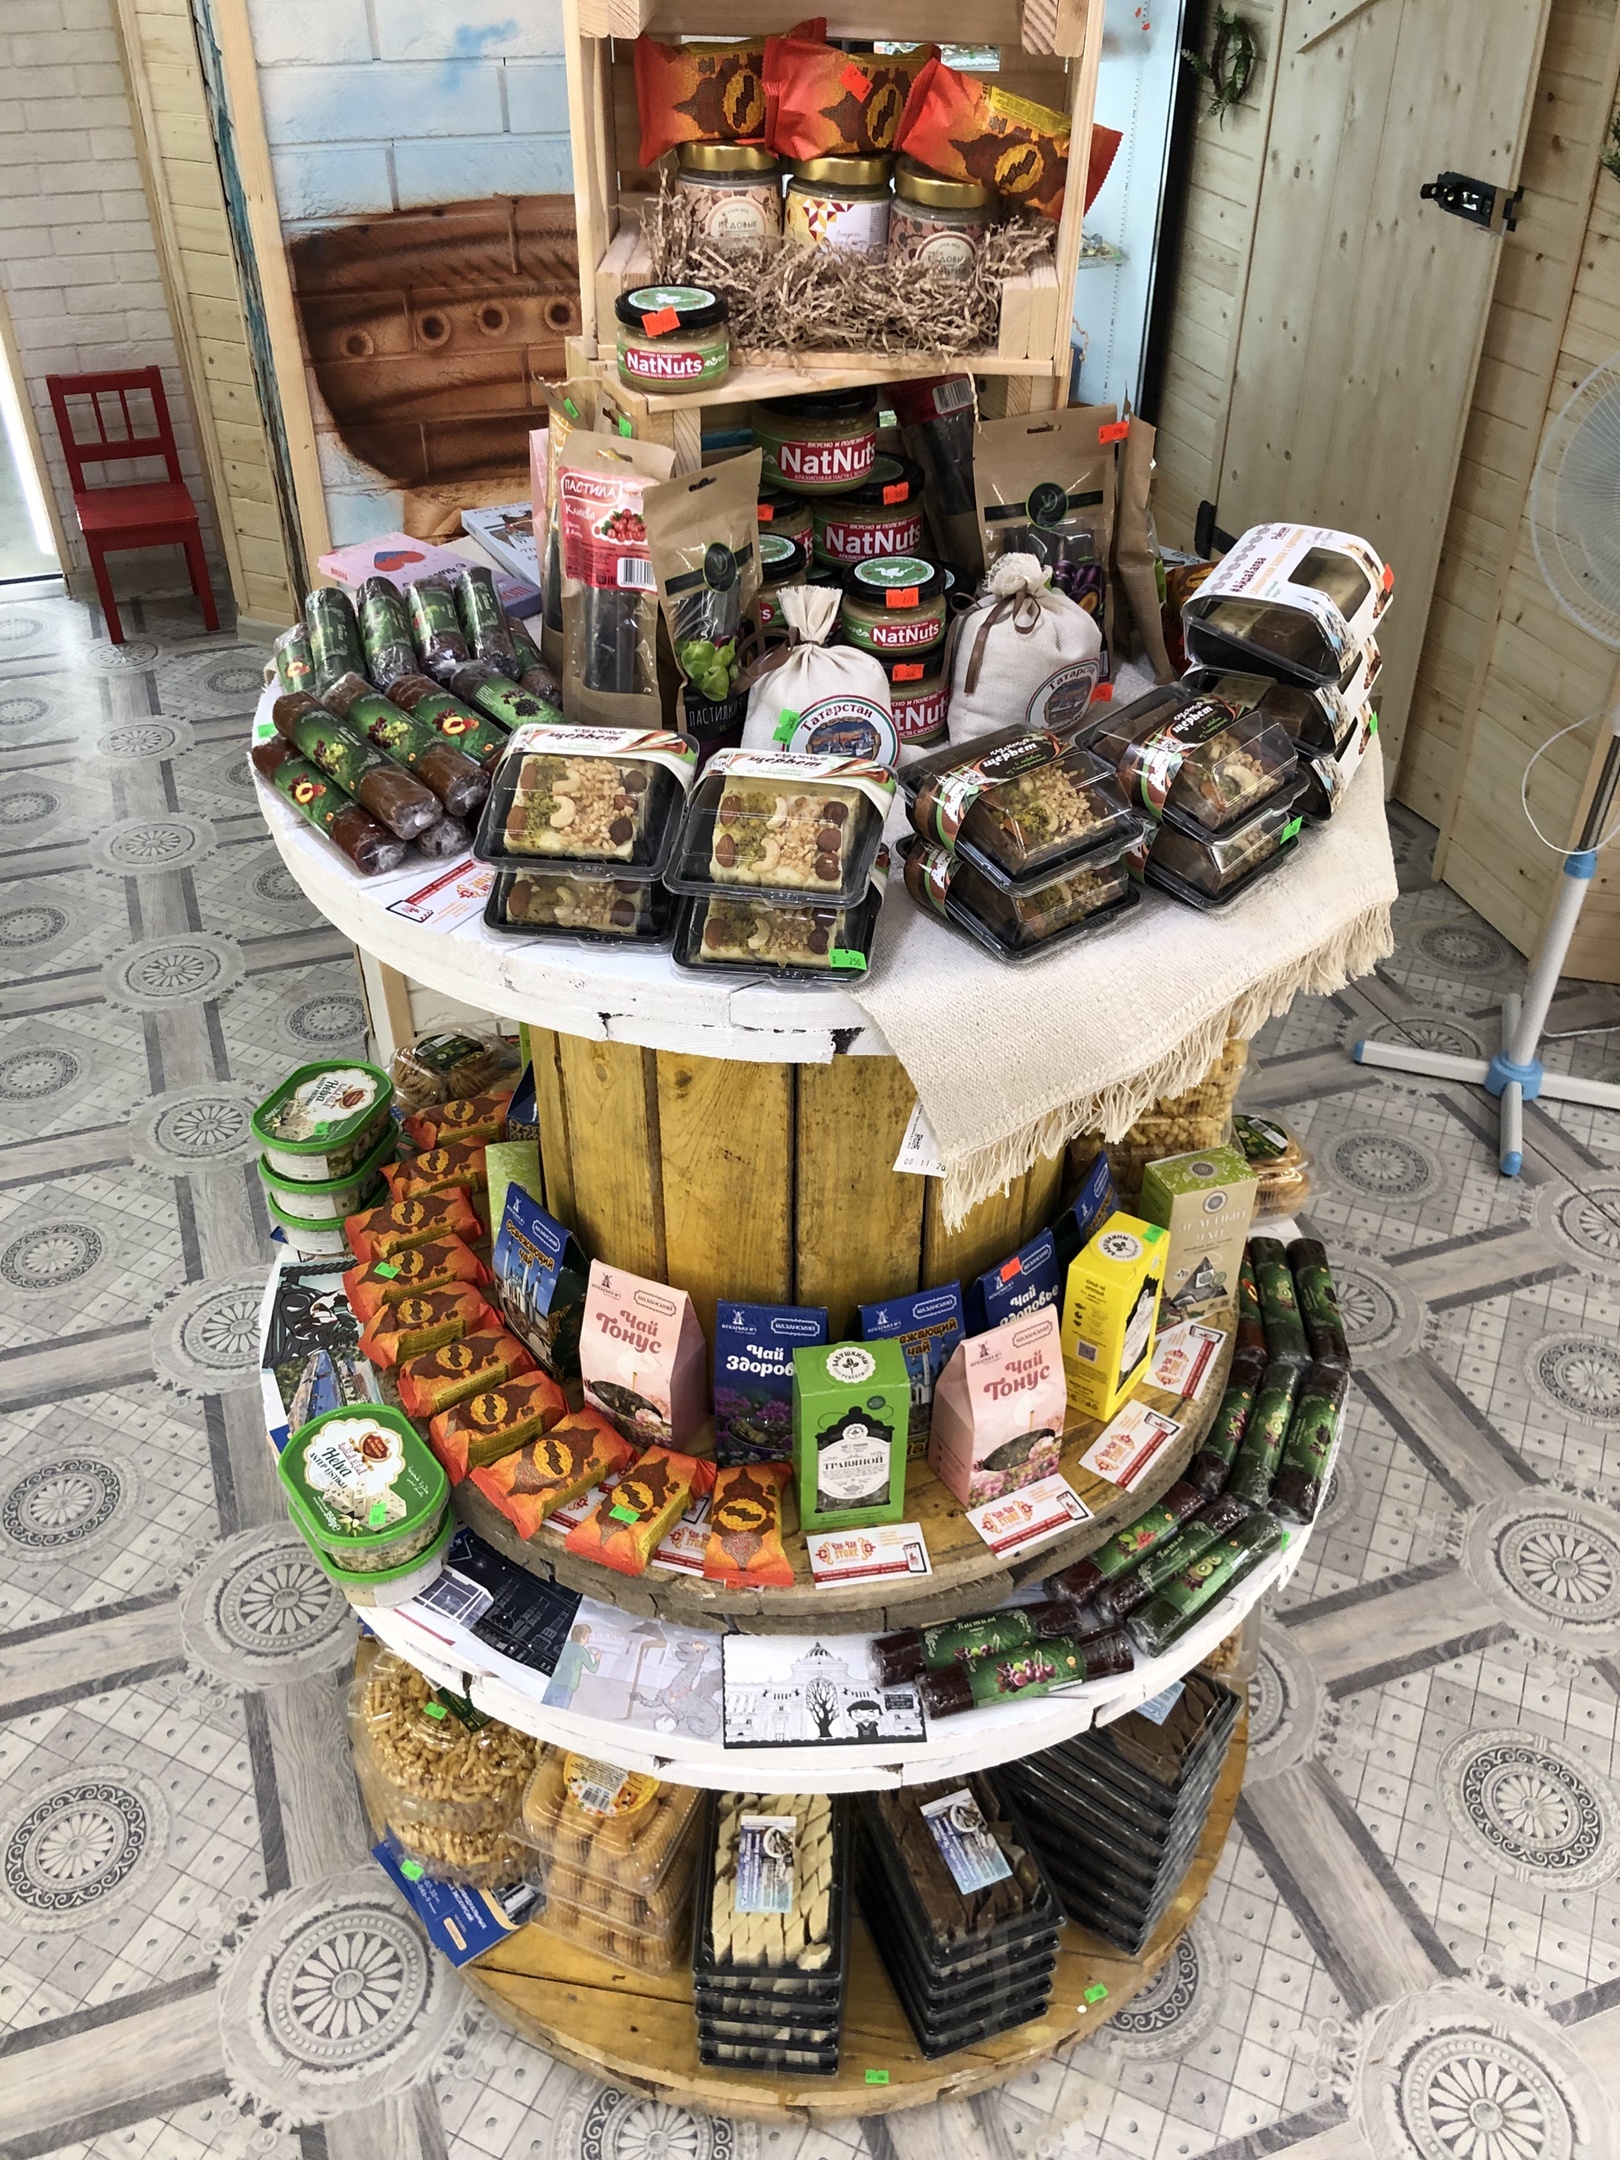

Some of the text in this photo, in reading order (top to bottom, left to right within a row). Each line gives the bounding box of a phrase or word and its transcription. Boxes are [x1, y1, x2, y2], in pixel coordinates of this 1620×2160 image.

[626, 351, 703, 375] NatNuts
[840, 436, 865, 446] ПОЛЕЗНО
[780, 441, 876, 475] NatNuts
[564, 478, 617, 499] ПАСТИЛА
[826, 524, 921, 555] NatNuts
[873, 623, 939, 643] NatNuts
[800, 703, 874, 732] Татарстан
[893, 693, 949, 730] tNut
[982, 743, 1038, 768] щербет
[849, 957, 862, 967] 250
[1010, 1284, 1037, 1306] Чай
[596, 1312, 662, 1354] Тонус
[620, 1309, 658, 1337] Чай
[899, 1316, 959, 1345] ежающий
[746, 1344, 784, 1361] Чай
[832, 1350, 870, 1367] БАБУШКИНЫ
[1005, 1349, 1043, 1374] Чай
[726, 1355, 795, 1377] Здоров
[983, 1365, 1050, 1401] Тонус
[309, 1452, 328, 1473] ANTEP
[321, 1446, 352, 1478] Helva
[824, 1455, 883, 1470] ТРАВЯНОЙ
[834, 1548, 859, 1560] STORE
